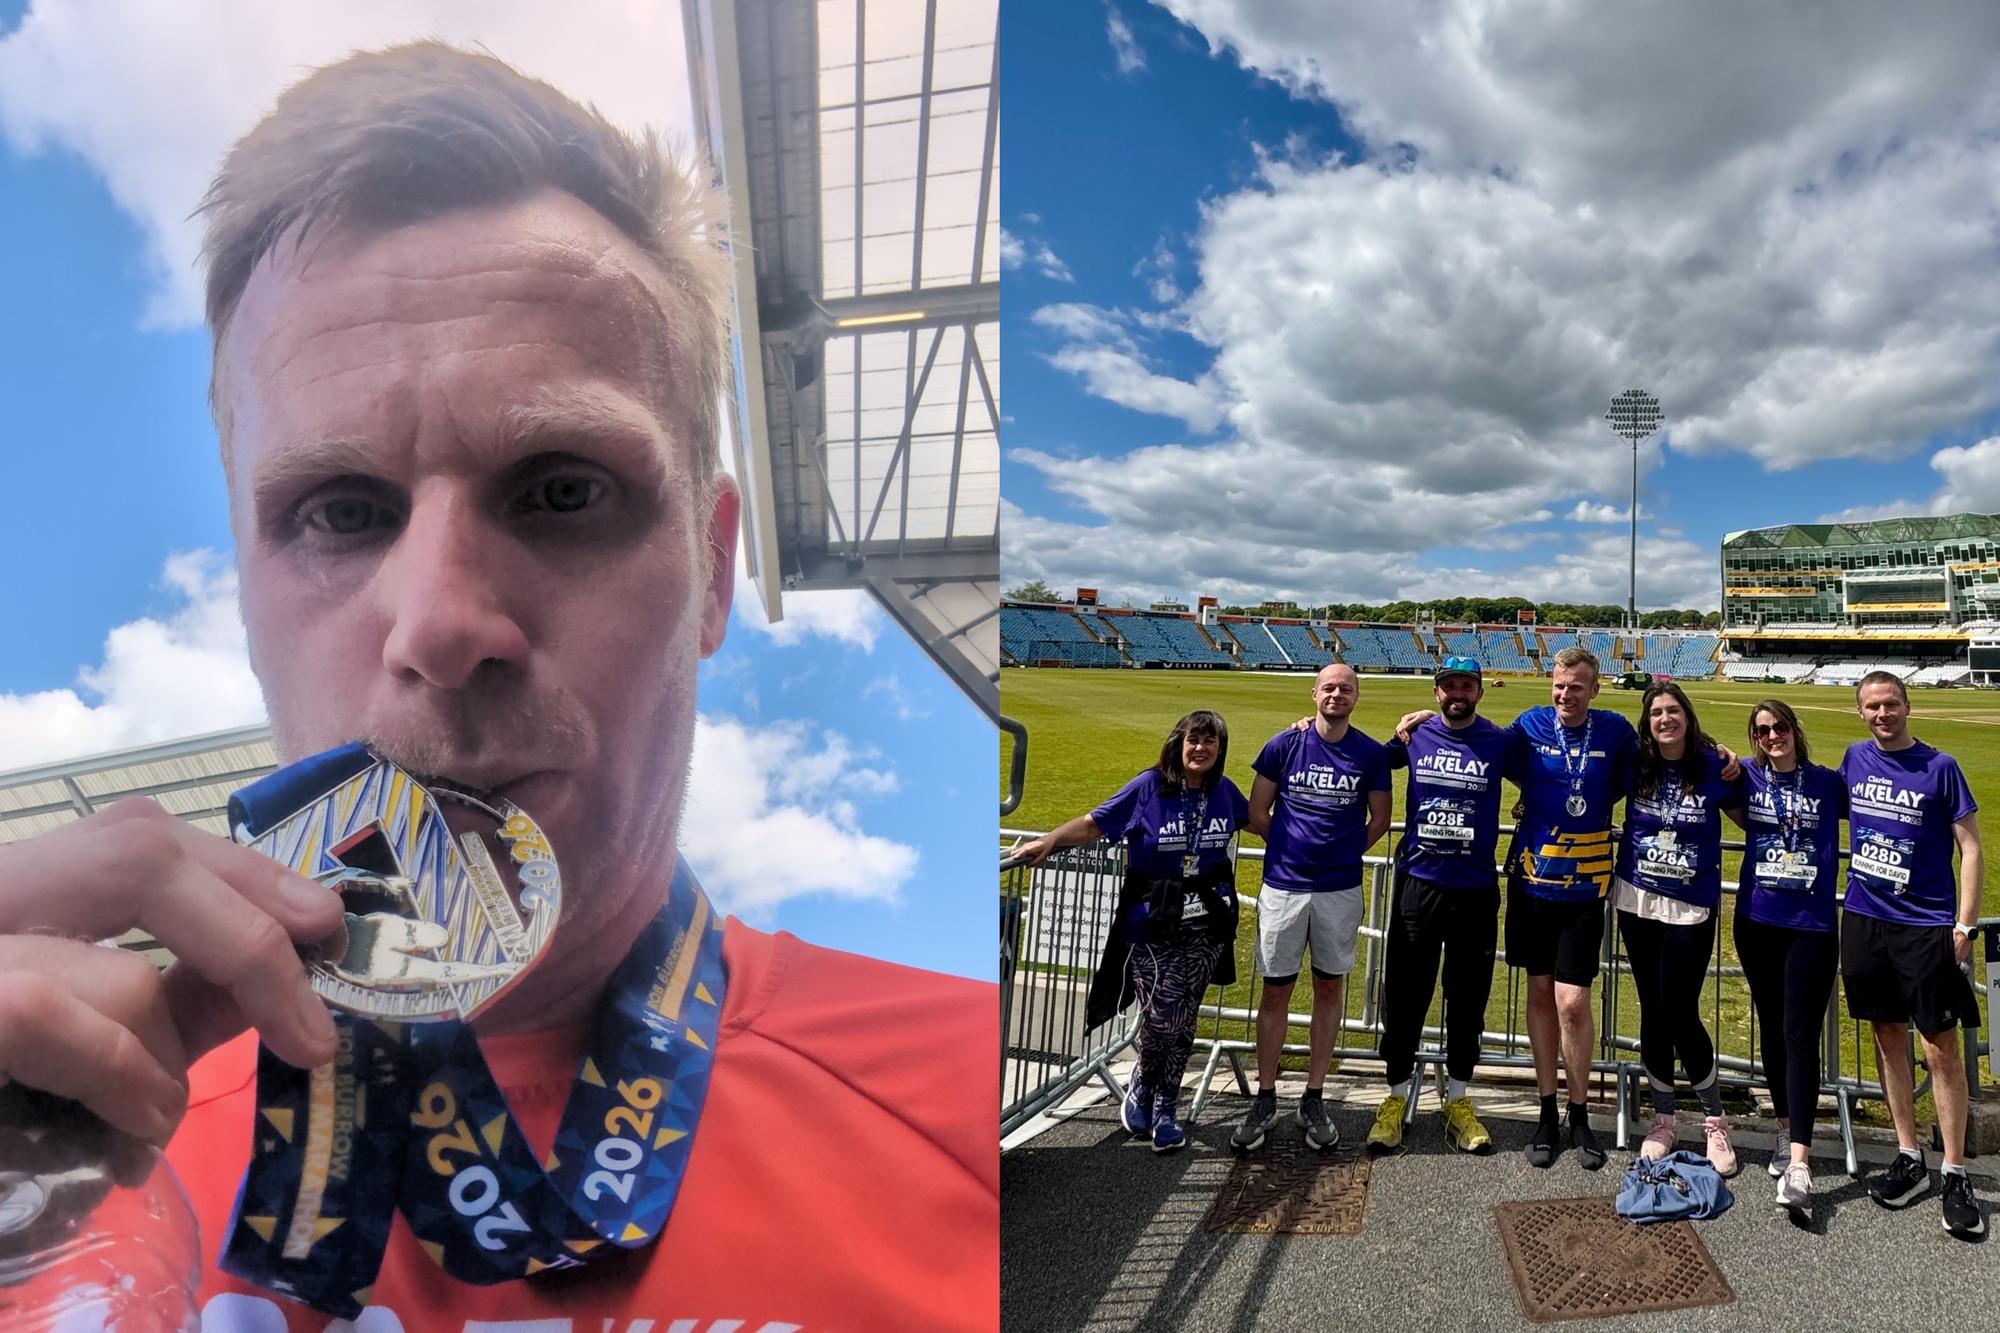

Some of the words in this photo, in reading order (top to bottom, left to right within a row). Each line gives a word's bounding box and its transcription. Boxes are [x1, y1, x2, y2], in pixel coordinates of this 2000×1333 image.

[1436, 748, 1462, 758] Clarion
[1309, 763, 1334, 773] Clarion
[1433, 755, 1490, 776] RELAY
[1306, 771, 1361, 791] RELAY
[1867, 775, 1893, 786] Clarion
[1863, 783, 1925, 808] RELAY
[1427, 811, 1465, 826] 028E
[497, 814, 561, 911] 2026
[1646, 848, 1690, 868] 028A
[1861, 842, 1902, 866] 028D
[1876, 865, 1888, 875] FOR
[656, 929, 687, 984] BURROW
[329, 1073, 355, 1181] BURROW
[583, 1077, 662, 1204] 2026
[410, 1082, 532, 1250] 2026
